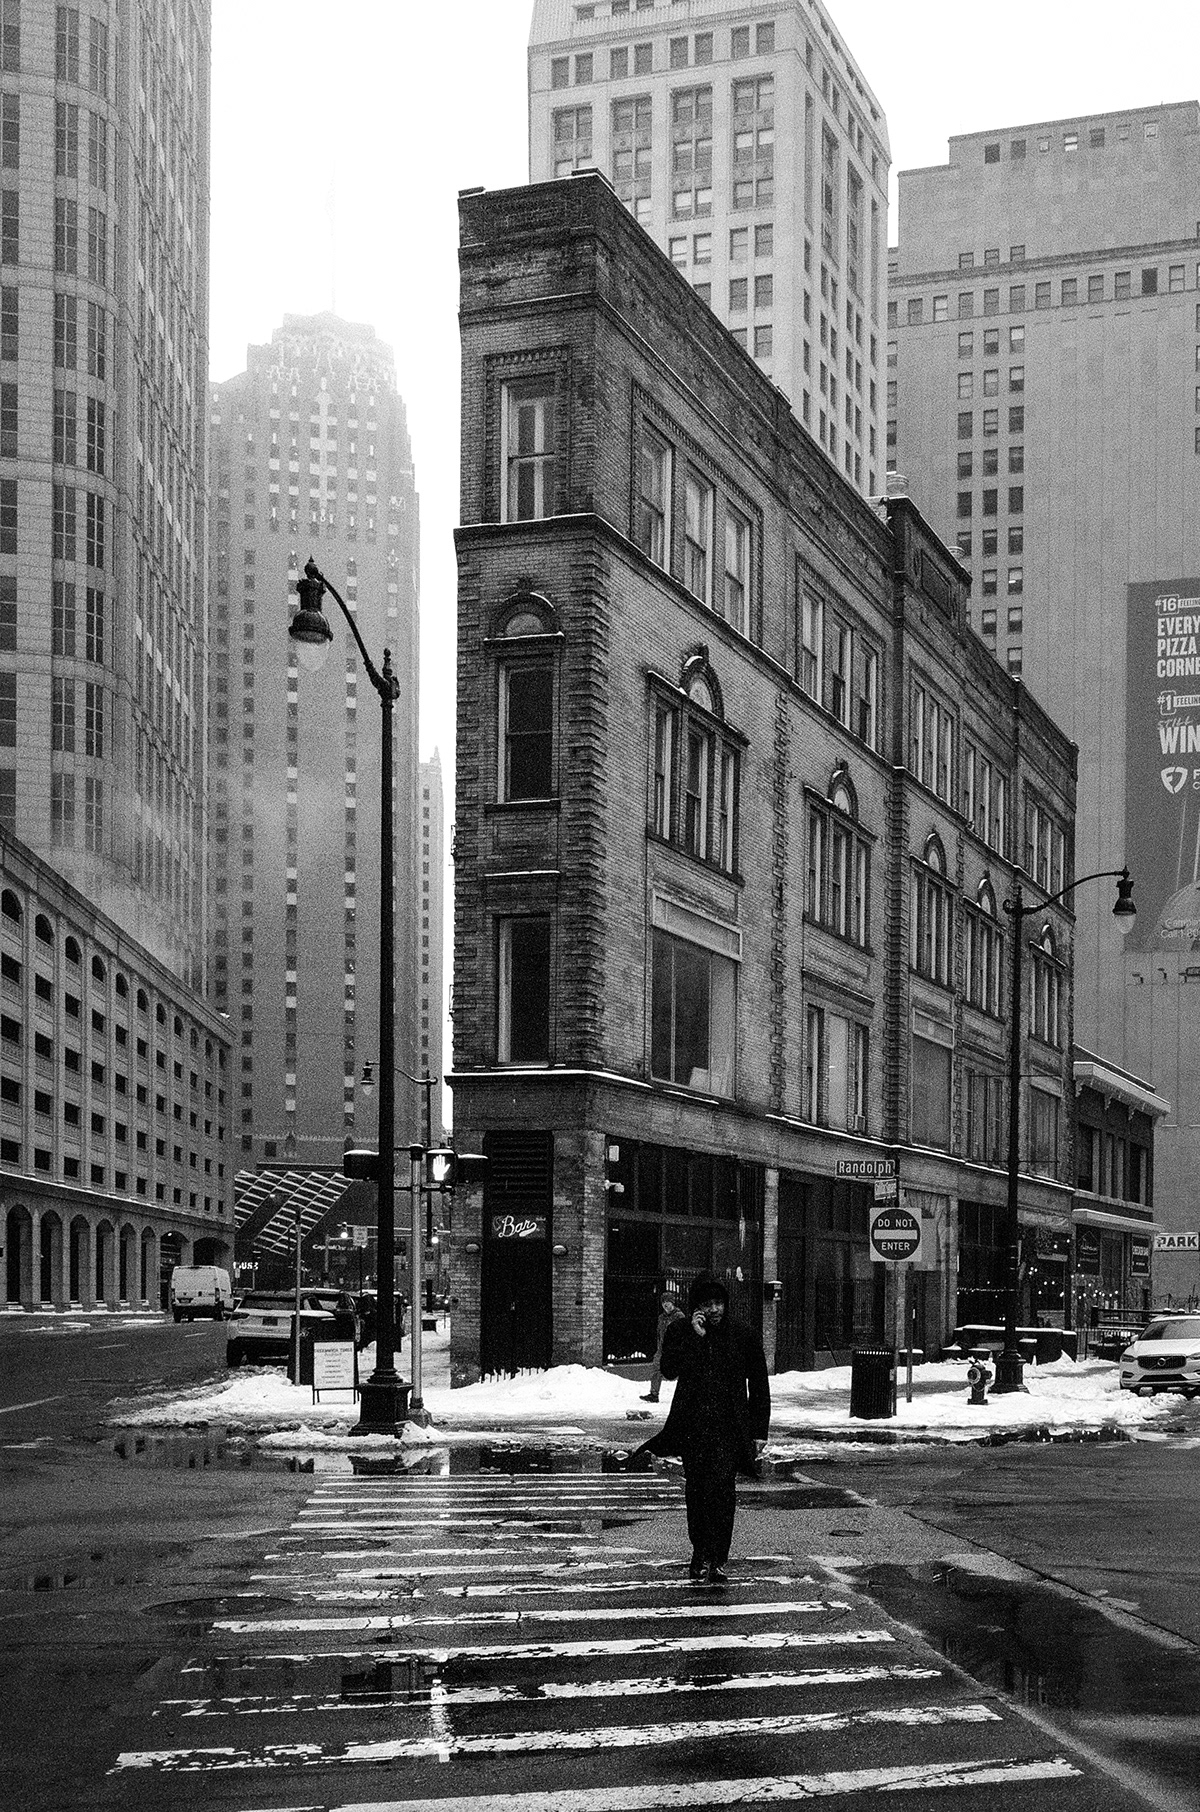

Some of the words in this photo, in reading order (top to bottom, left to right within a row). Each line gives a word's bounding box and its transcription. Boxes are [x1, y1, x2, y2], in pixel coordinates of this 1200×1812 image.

[1155, 598, 1177, 612] #16
[1157, 615, 1200, 637] EVERY
[1157, 637, 1197, 657] PIZZA
[1157, 657, 1200, 678] CORNE
[1157, 695, 1172, 711] #1
[1176, 696, 1200, 705] FEELIN
[838, 1161, 892, 1176] Randolph
[497, 1214, 537, 1238] Bar
[878, 1218, 890, 1228] DO
[895, 1218, 914, 1228] NOT
[881, 1241, 911, 1251] ENTER
[1157, 1236, 1197, 1247] PARK
